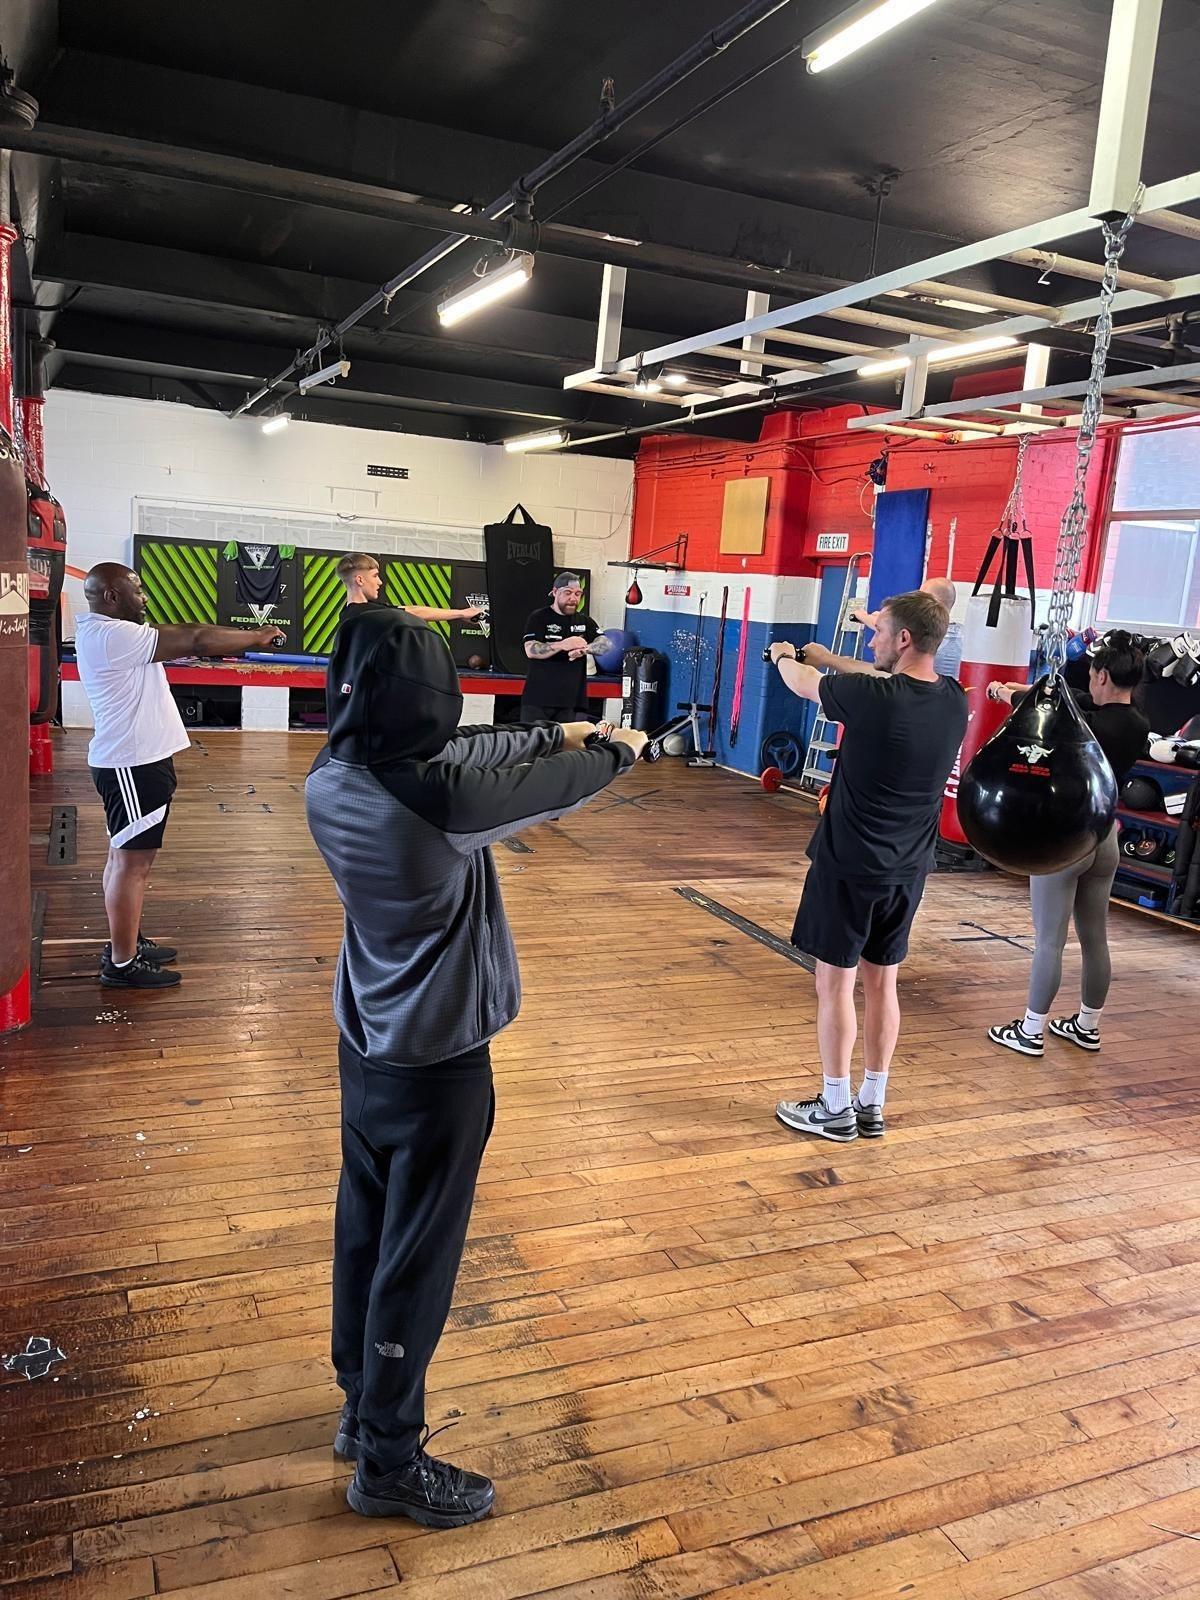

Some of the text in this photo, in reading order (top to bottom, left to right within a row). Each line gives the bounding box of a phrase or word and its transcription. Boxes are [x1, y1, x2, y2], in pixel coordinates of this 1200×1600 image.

[506, 540, 541, 560] EVERLAST
[819, 536, 847, 549] FIRE EXIT
